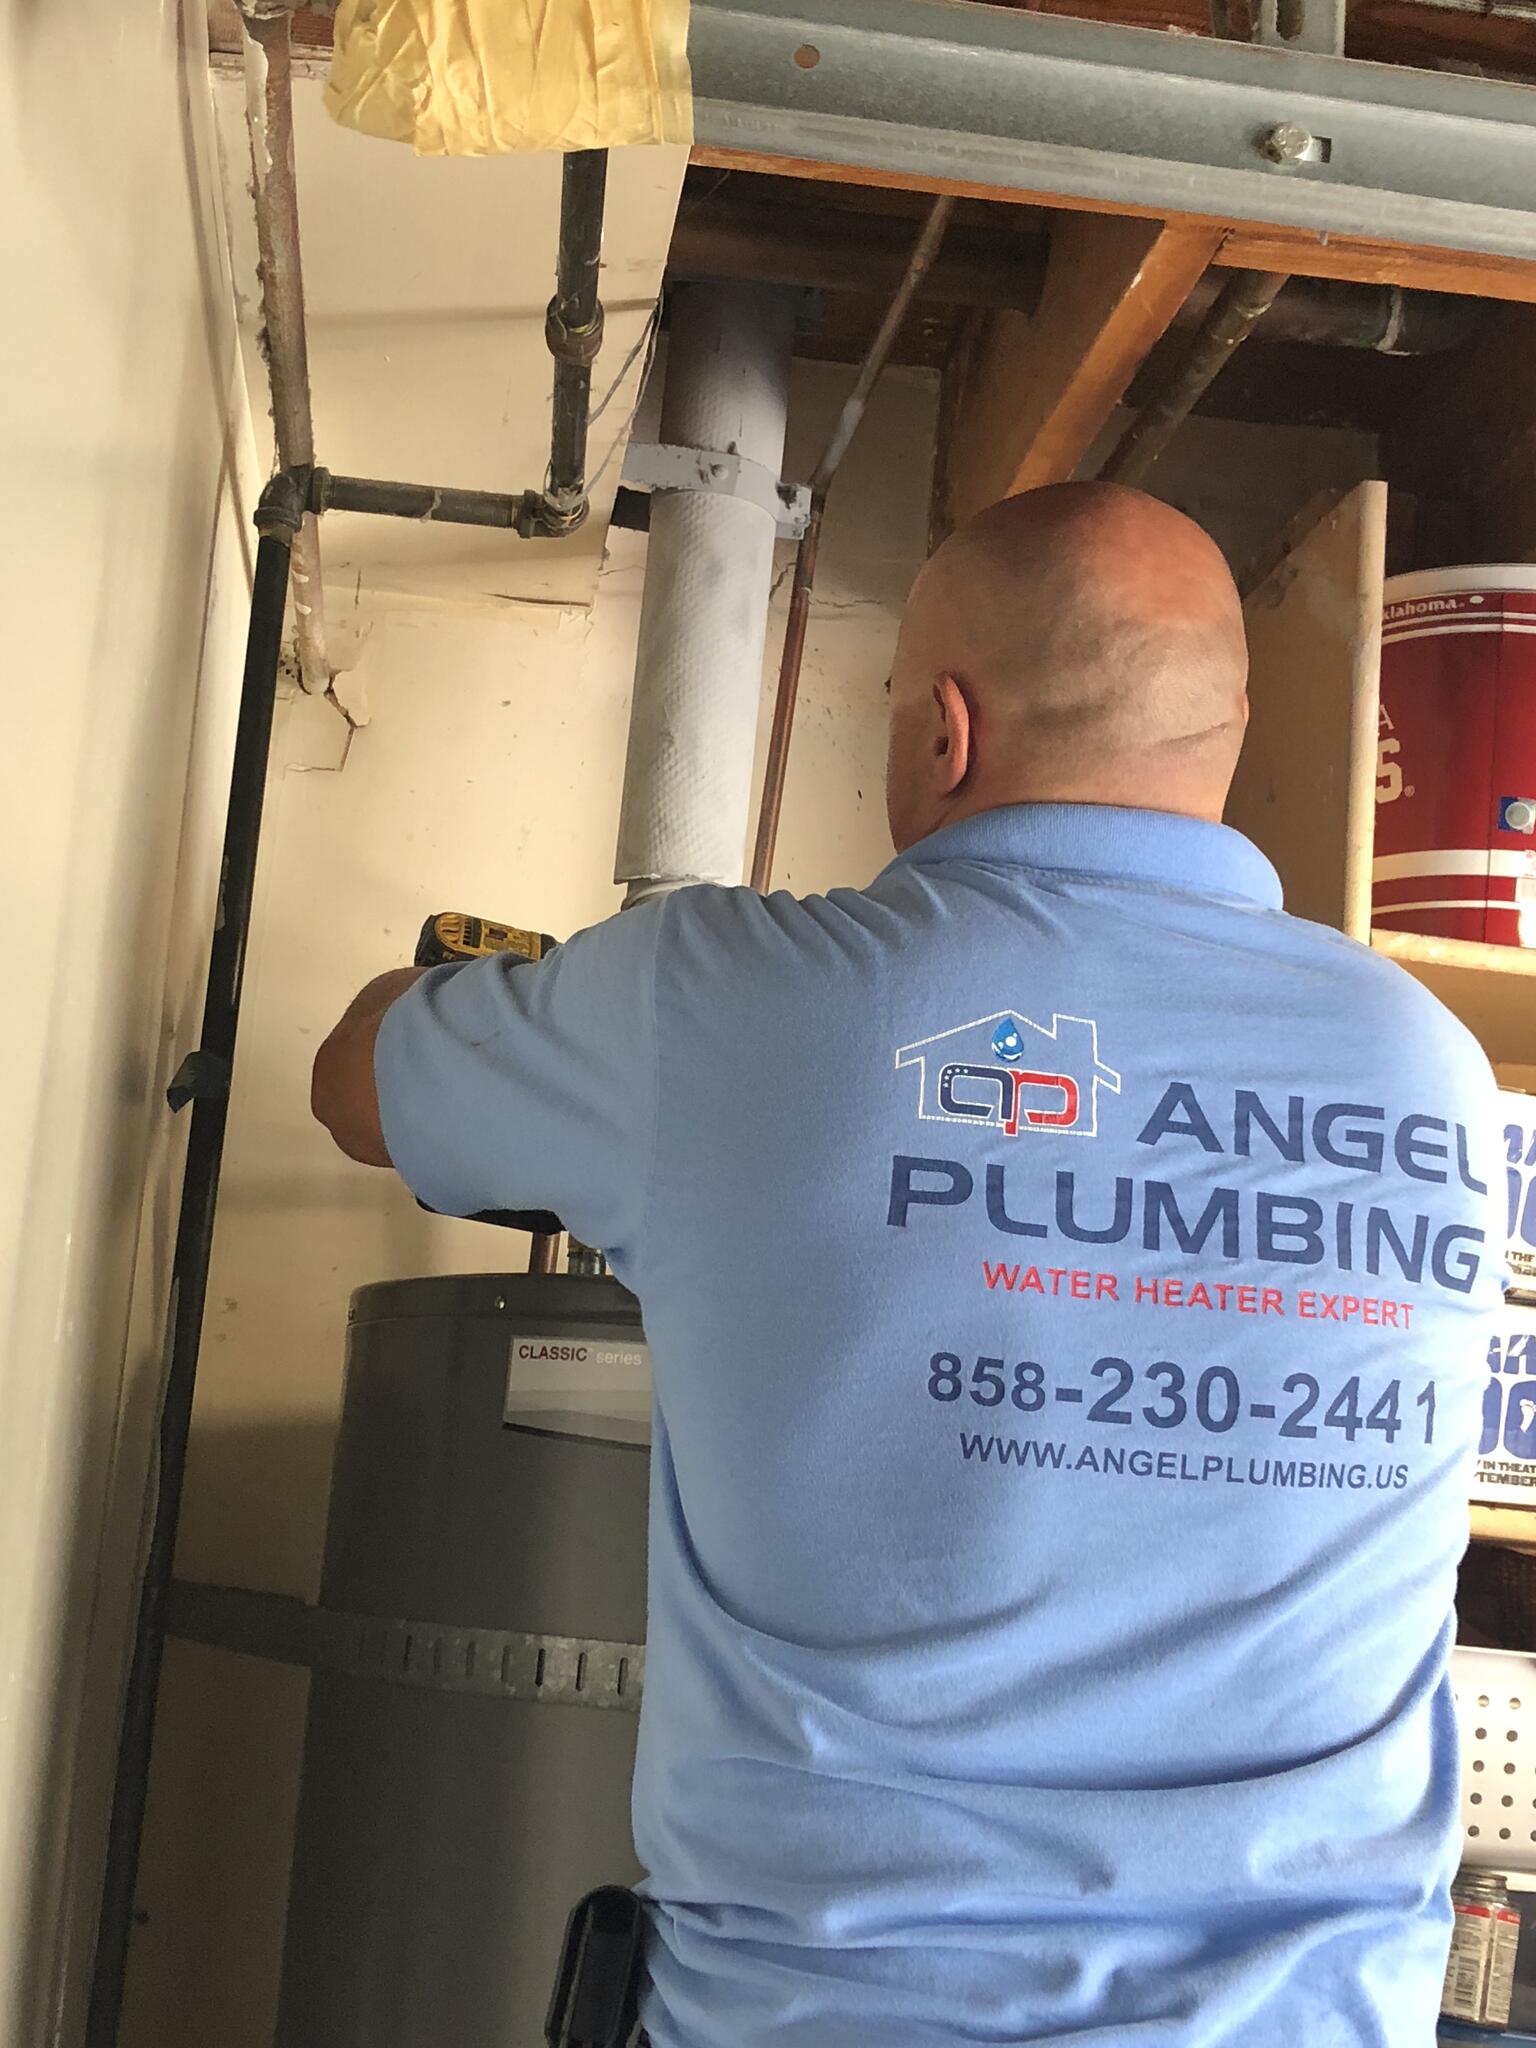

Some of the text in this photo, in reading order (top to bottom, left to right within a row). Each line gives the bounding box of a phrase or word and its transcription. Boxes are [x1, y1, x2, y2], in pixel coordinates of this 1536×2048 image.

[1136, 1082, 1488, 1196] ANGEL
[886, 1155, 1487, 1294] PLUMBING
[983, 1261, 1414, 1329] WATER HEATER EXPERT
[519, 1345, 642, 1366] CLASSIC series
[927, 1351, 1436, 1444] 858-230-2441
[959, 1432, 1409, 1490] WWW.ANGELPLUMBING.US
[1474, 1472, 1536, 1487] TEMBER
